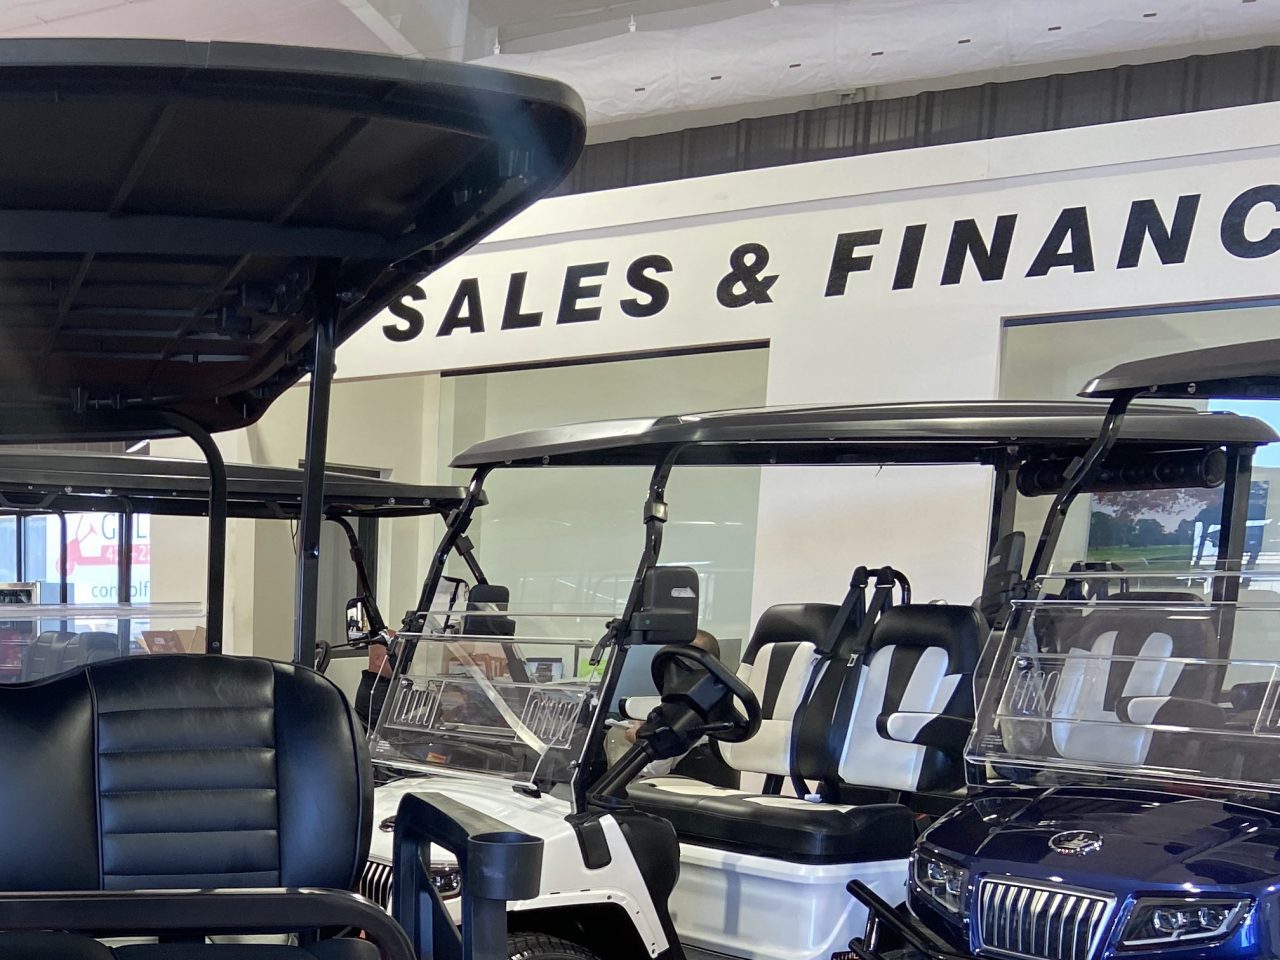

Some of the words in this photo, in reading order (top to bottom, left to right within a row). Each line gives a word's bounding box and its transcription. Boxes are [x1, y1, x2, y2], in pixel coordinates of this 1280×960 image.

[383, 256, 673, 342] SALES
[716, 243, 780, 308] &
[824, 184, 1280, 297] FINANC
